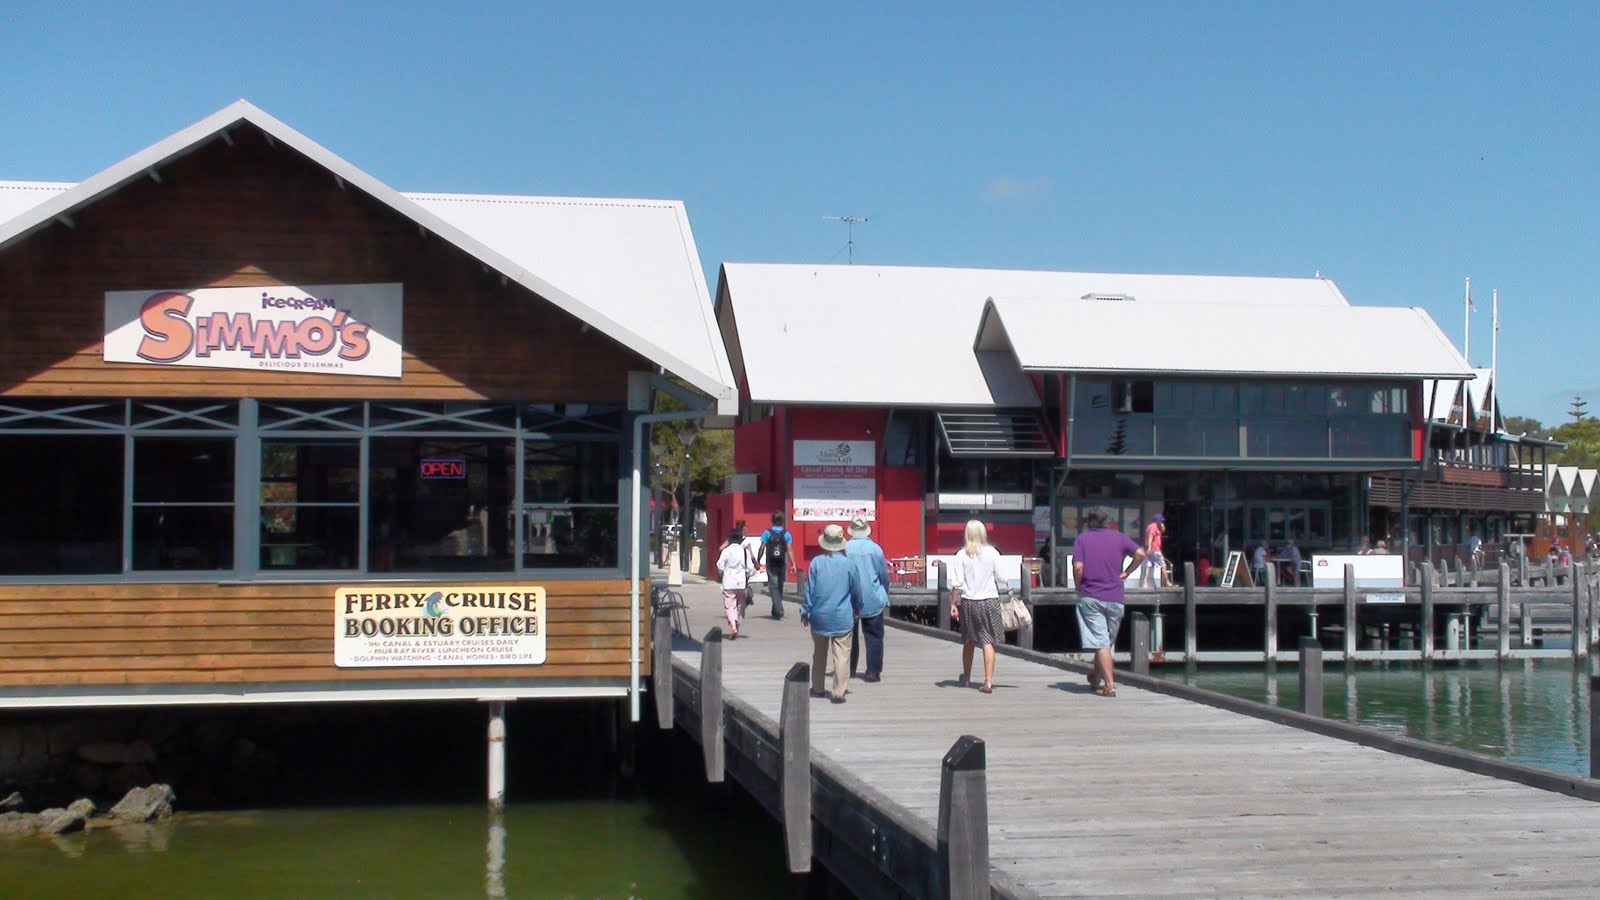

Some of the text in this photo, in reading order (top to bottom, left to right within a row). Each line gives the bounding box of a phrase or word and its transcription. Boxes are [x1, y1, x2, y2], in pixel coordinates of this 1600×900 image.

[259, 360, 344, 369] DELICIOUS DILEMMAS
[421, 462, 463, 476] OPEN
[823, 466, 844, 475] Dining
[855, 466, 868, 475] Day
[344, 592, 537, 615] FERRY CRUISE
[344, 615, 539, 638] BOOKING OFFICE
[519, 652, 533, 660] LIFE
